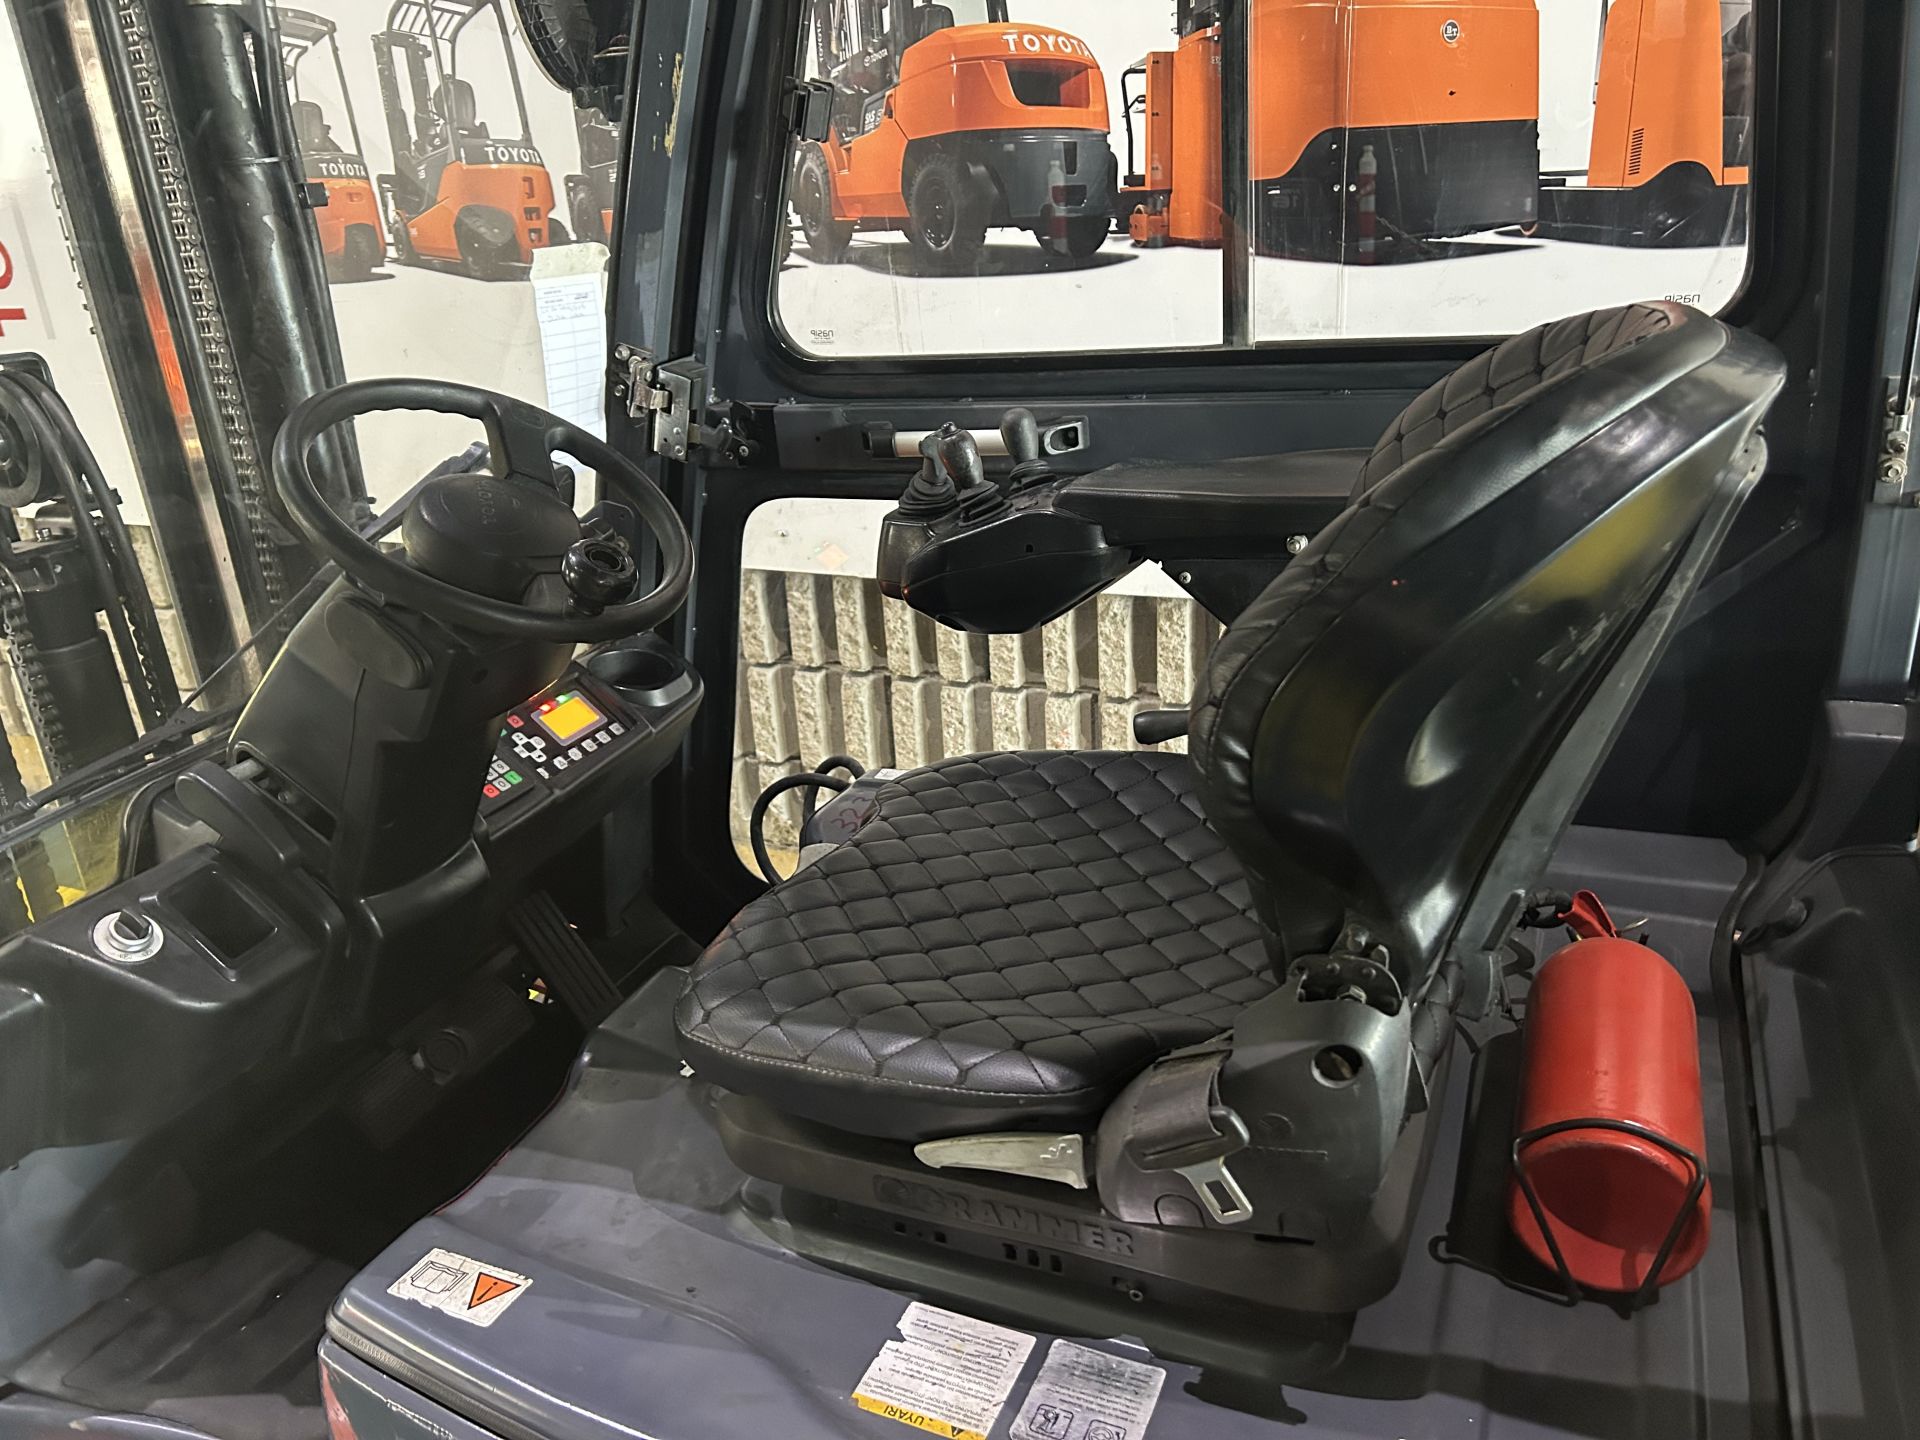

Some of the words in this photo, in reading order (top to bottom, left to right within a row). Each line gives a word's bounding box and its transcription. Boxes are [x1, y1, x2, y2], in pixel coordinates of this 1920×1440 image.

[1002, 33, 1093, 58] TOYOTA
[485, 146, 543, 165] TOYOTA
[318, 162, 367, 178] TOYOTA
[882, 1404, 926, 1427] UYARI
